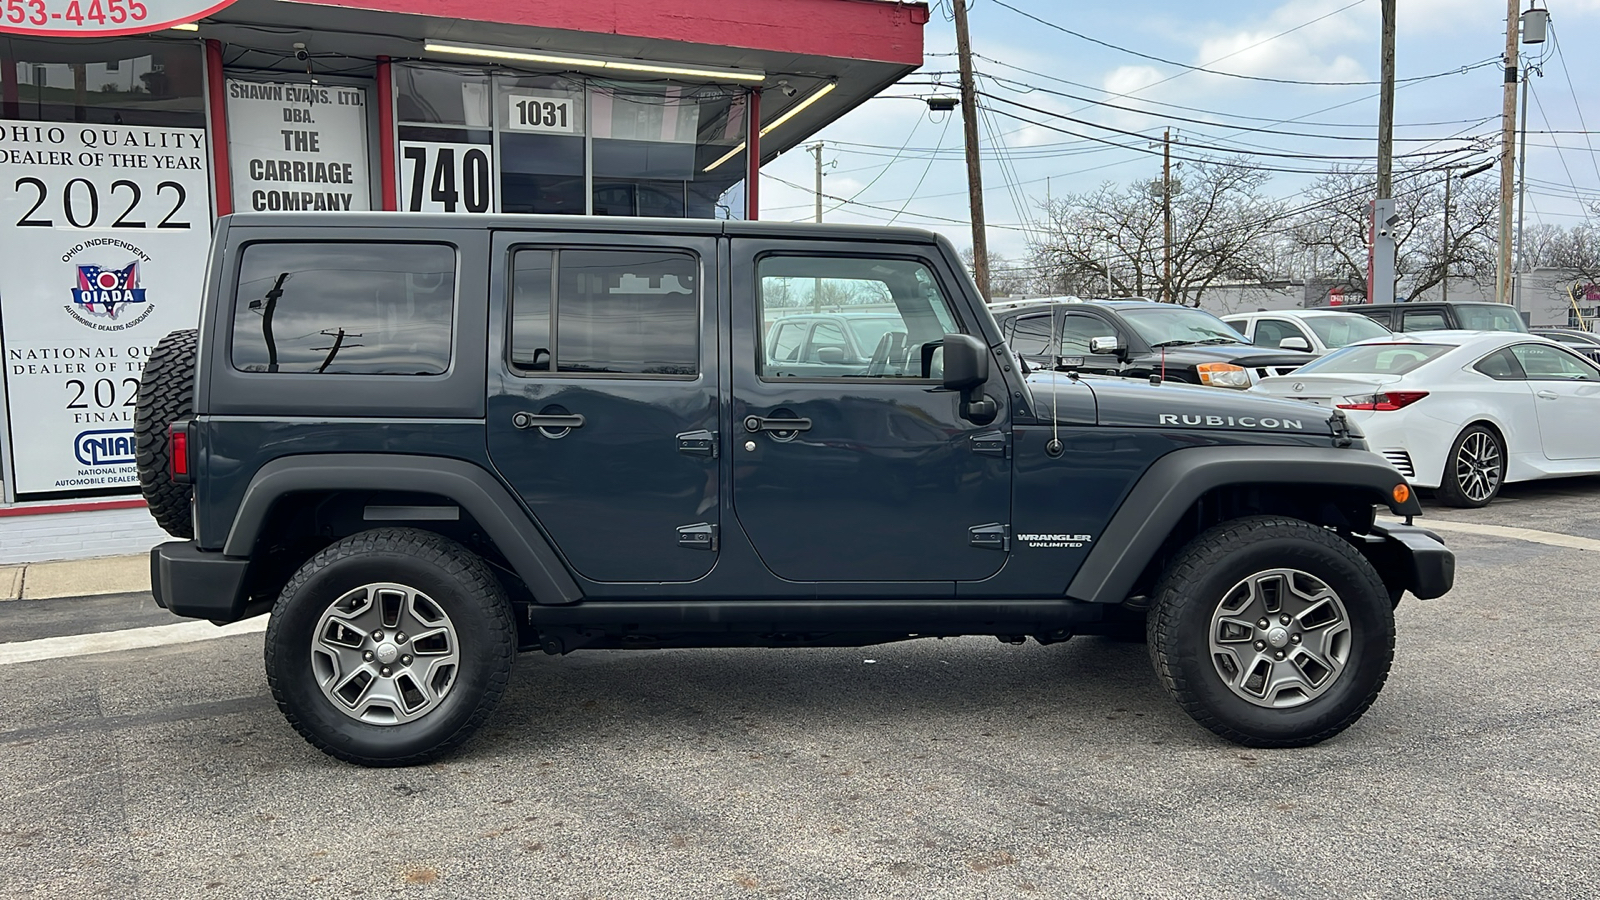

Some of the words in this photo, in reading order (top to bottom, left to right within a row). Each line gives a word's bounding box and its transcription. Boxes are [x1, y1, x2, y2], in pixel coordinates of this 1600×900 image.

[0, 0, 148, 26] 53-4455
[230, 84, 283, 101] SHAWN
[285, 87, 332, 104] EVANS.
[337, 91, 364, 107] LTD.
[283, 108, 315, 123] DBA.
[516, 100, 567, 127] 1031
[80, 128, 203, 149] QUALITY
[281, 130, 320, 152] THE
[0, 149, 73, 165] DEALER
[78, 152, 104, 167] OF
[109, 153, 148, 168] THE
[152, 155, 202, 170] YEAR
[249, 158, 353, 184] CARRIAGE
[404, 147, 490, 213] 740
[15, 176, 191, 229] 2022
[252, 189, 353, 211] COMPANY
[61, 243, 84, 263] OHIO
[84, 237, 152, 263] INDEPENDENT
[81, 289, 134, 303] OIADA
[63, 303, 97, 330] AUTOMOBILE
[97, 324, 125, 332] DEALERS
[125, 303, 155, 329] ASSOCIATION
[9, 347, 118, 360] NATIONAL
[13, 362, 86, 375] DEALER
[95, 362, 117, 373] OF
[1159, 413, 1302, 430] RUBICON
[55, 478, 105, 487] AUTOMOBILE
[78, 468, 117, 476] NATIONAL
[1017, 534, 1092, 542] WRANGLER
